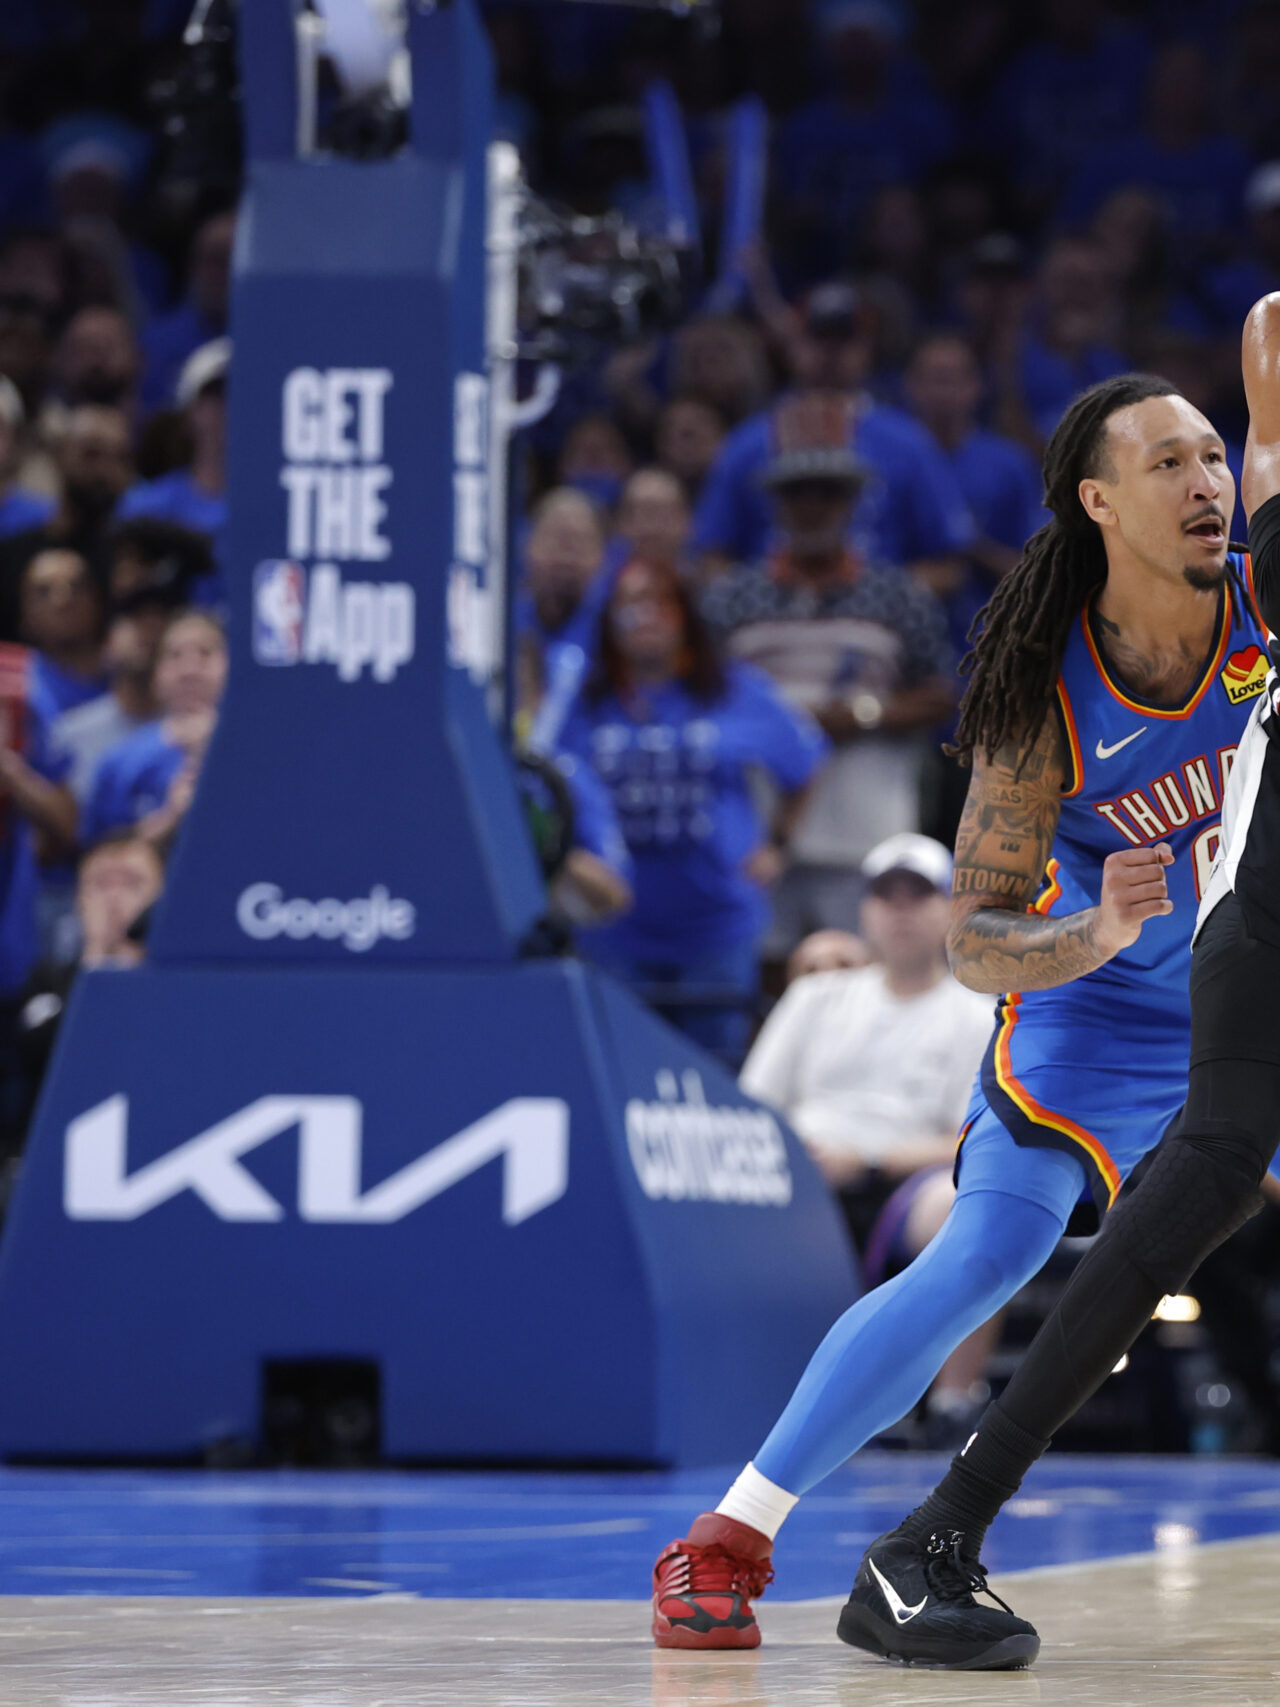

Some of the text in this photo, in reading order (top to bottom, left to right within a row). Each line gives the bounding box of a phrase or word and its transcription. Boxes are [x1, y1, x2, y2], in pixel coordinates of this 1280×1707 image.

[282, 366, 394, 463] GET
[280, 464, 394, 562] THE
[302, 562, 416, 682] App
[237, 882, 416, 952] Google
[953, 867, 1031, 897] ETOWN
